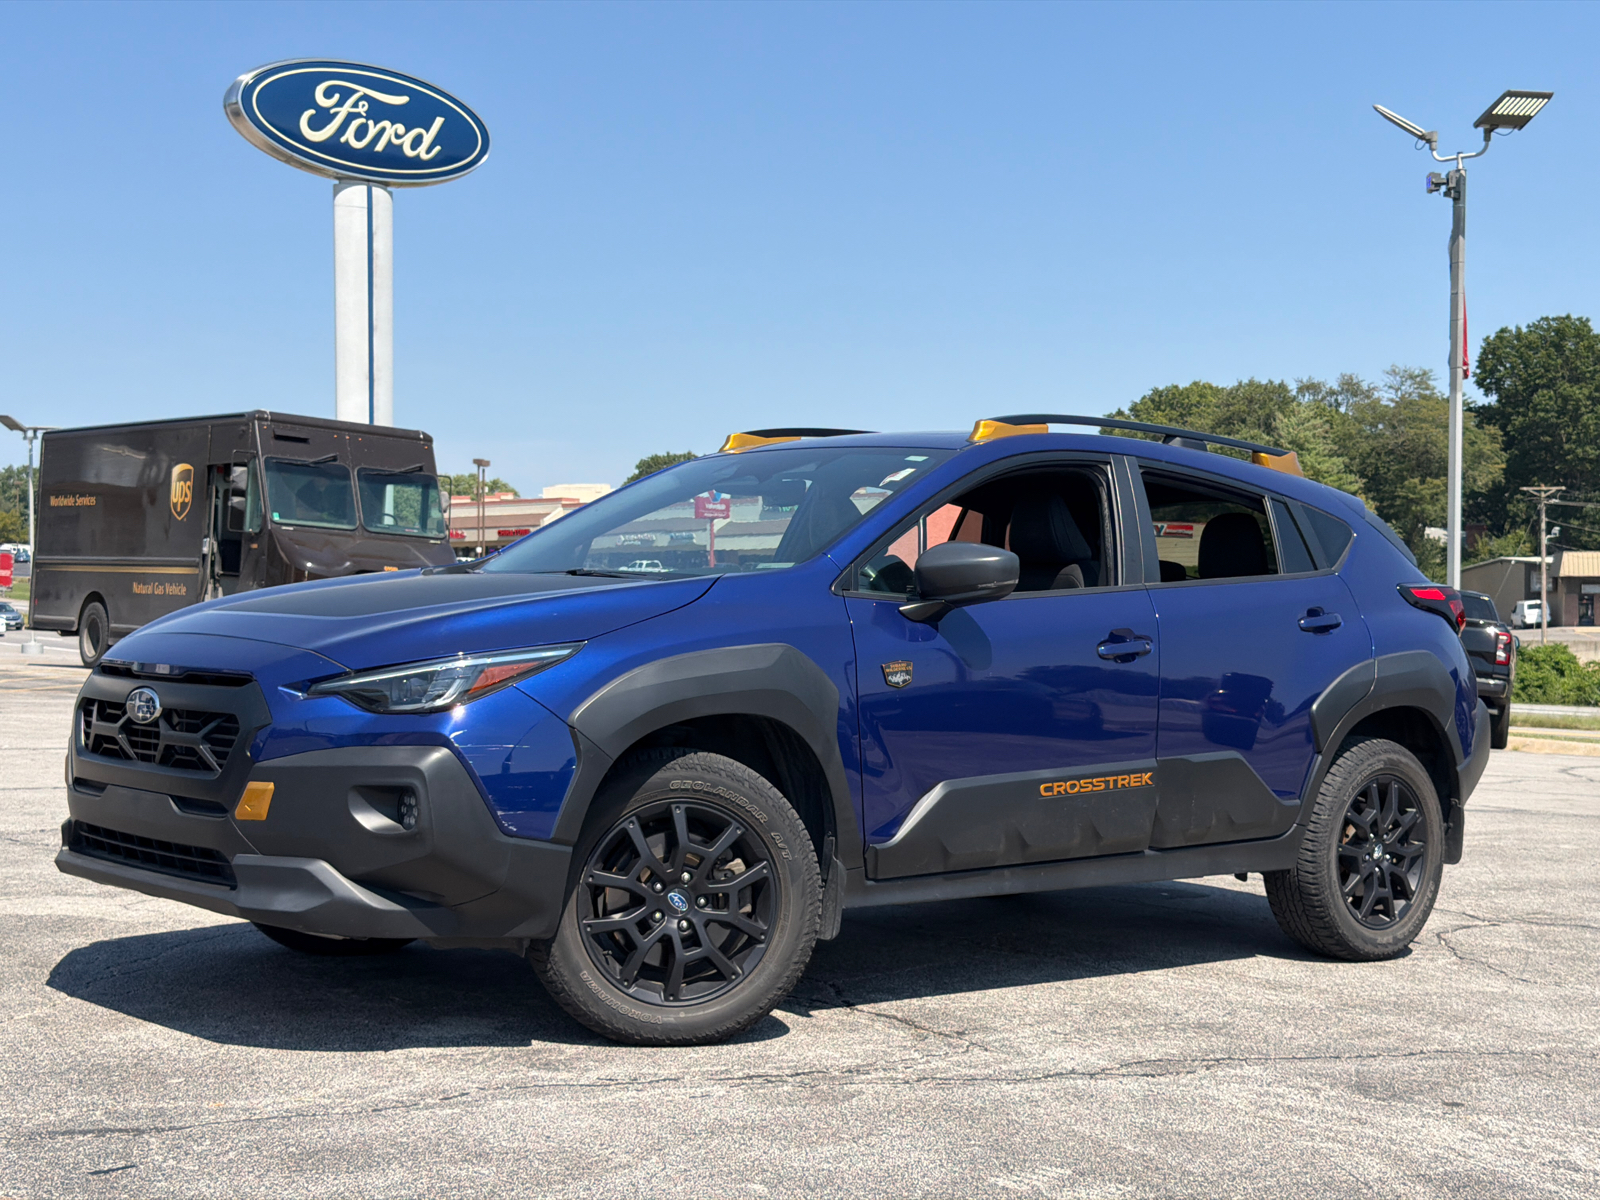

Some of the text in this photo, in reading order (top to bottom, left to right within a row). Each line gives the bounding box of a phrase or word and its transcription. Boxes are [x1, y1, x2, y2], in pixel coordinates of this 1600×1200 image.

[299, 80, 446, 161] Ford
[50, 494, 96, 507] Worldwide Services
[172, 481, 192, 512] ups
[133, 581, 187, 596] Natural Gas Vehicle
[1039, 771, 1154, 797] CROSSTREK
[669, 780, 769, 824] GEOLANDAR
[770, 832, 792, 861] A/T
[580, 970, 663, 1025] YOKOHAMA
